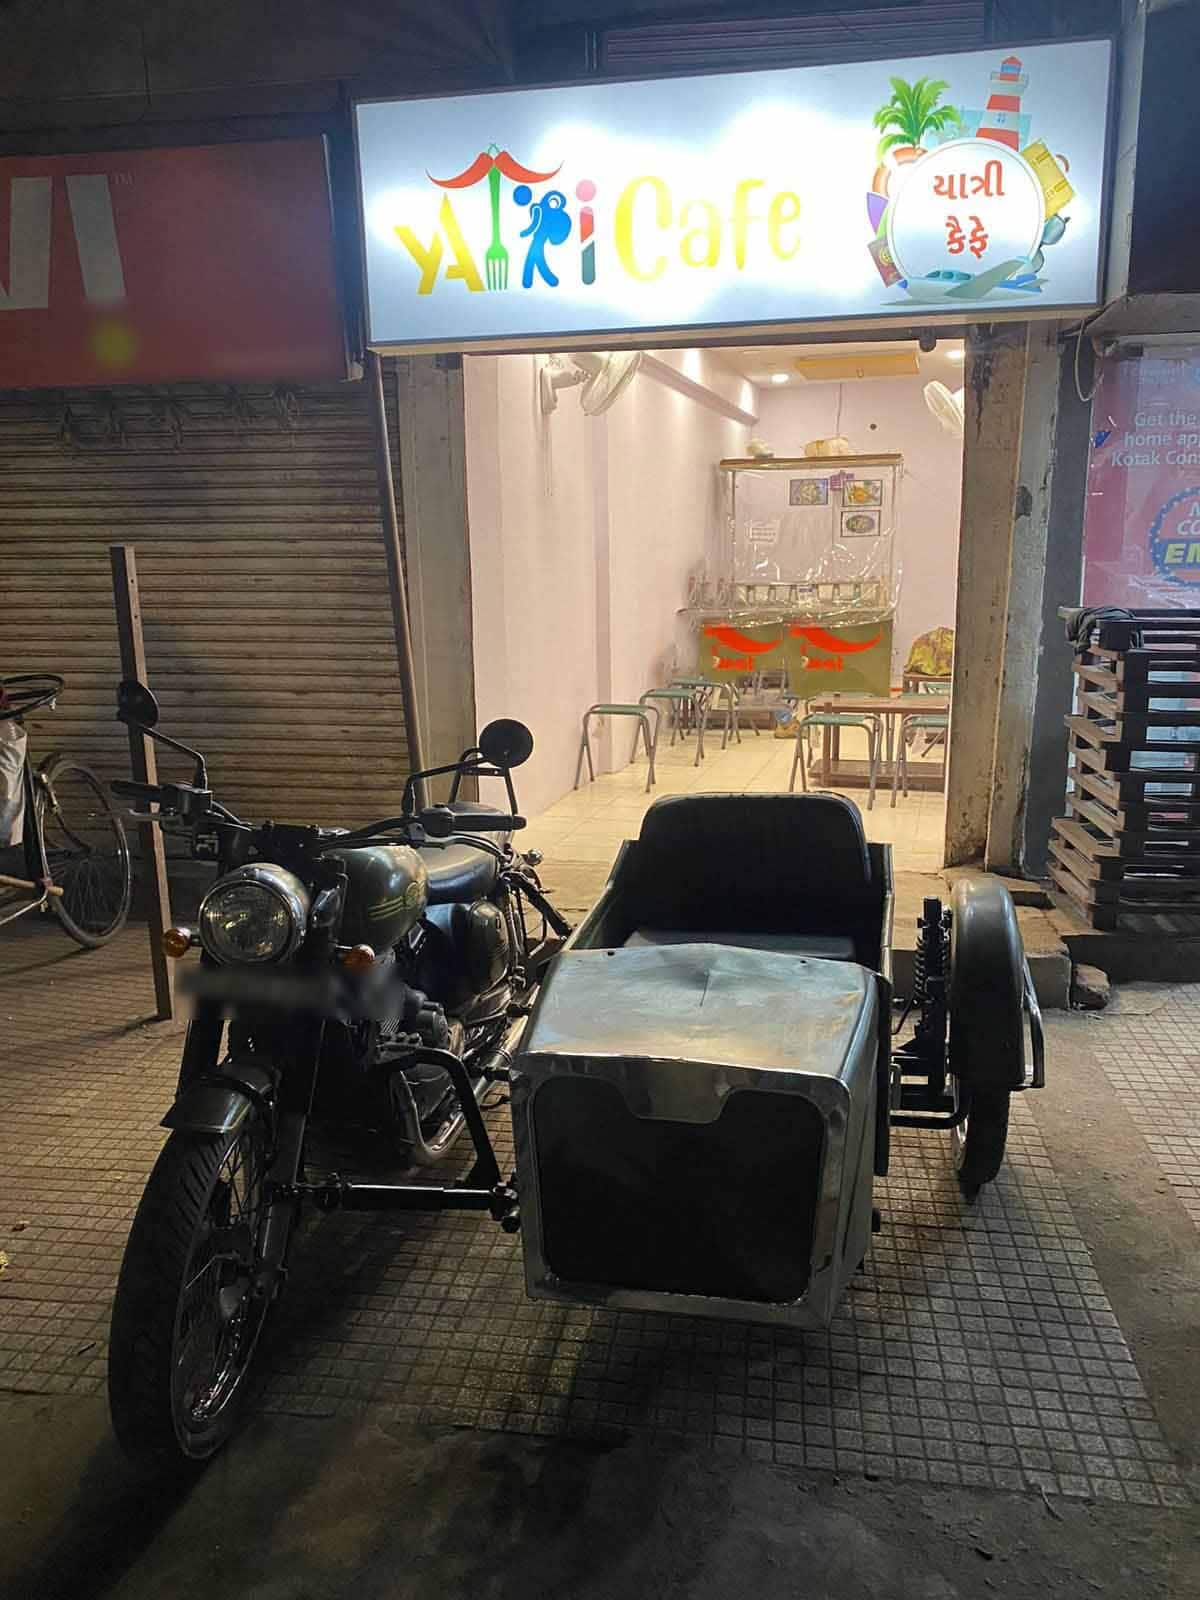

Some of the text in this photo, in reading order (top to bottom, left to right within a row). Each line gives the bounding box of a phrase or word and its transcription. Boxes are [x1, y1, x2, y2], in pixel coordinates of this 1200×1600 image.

[933, 160, 1005, 200] યાત્રી
[613, 175, 801, 282] Cafe
[1167, 410, 1198, 427] the
[1124, 431, 1200, 449] home ap
